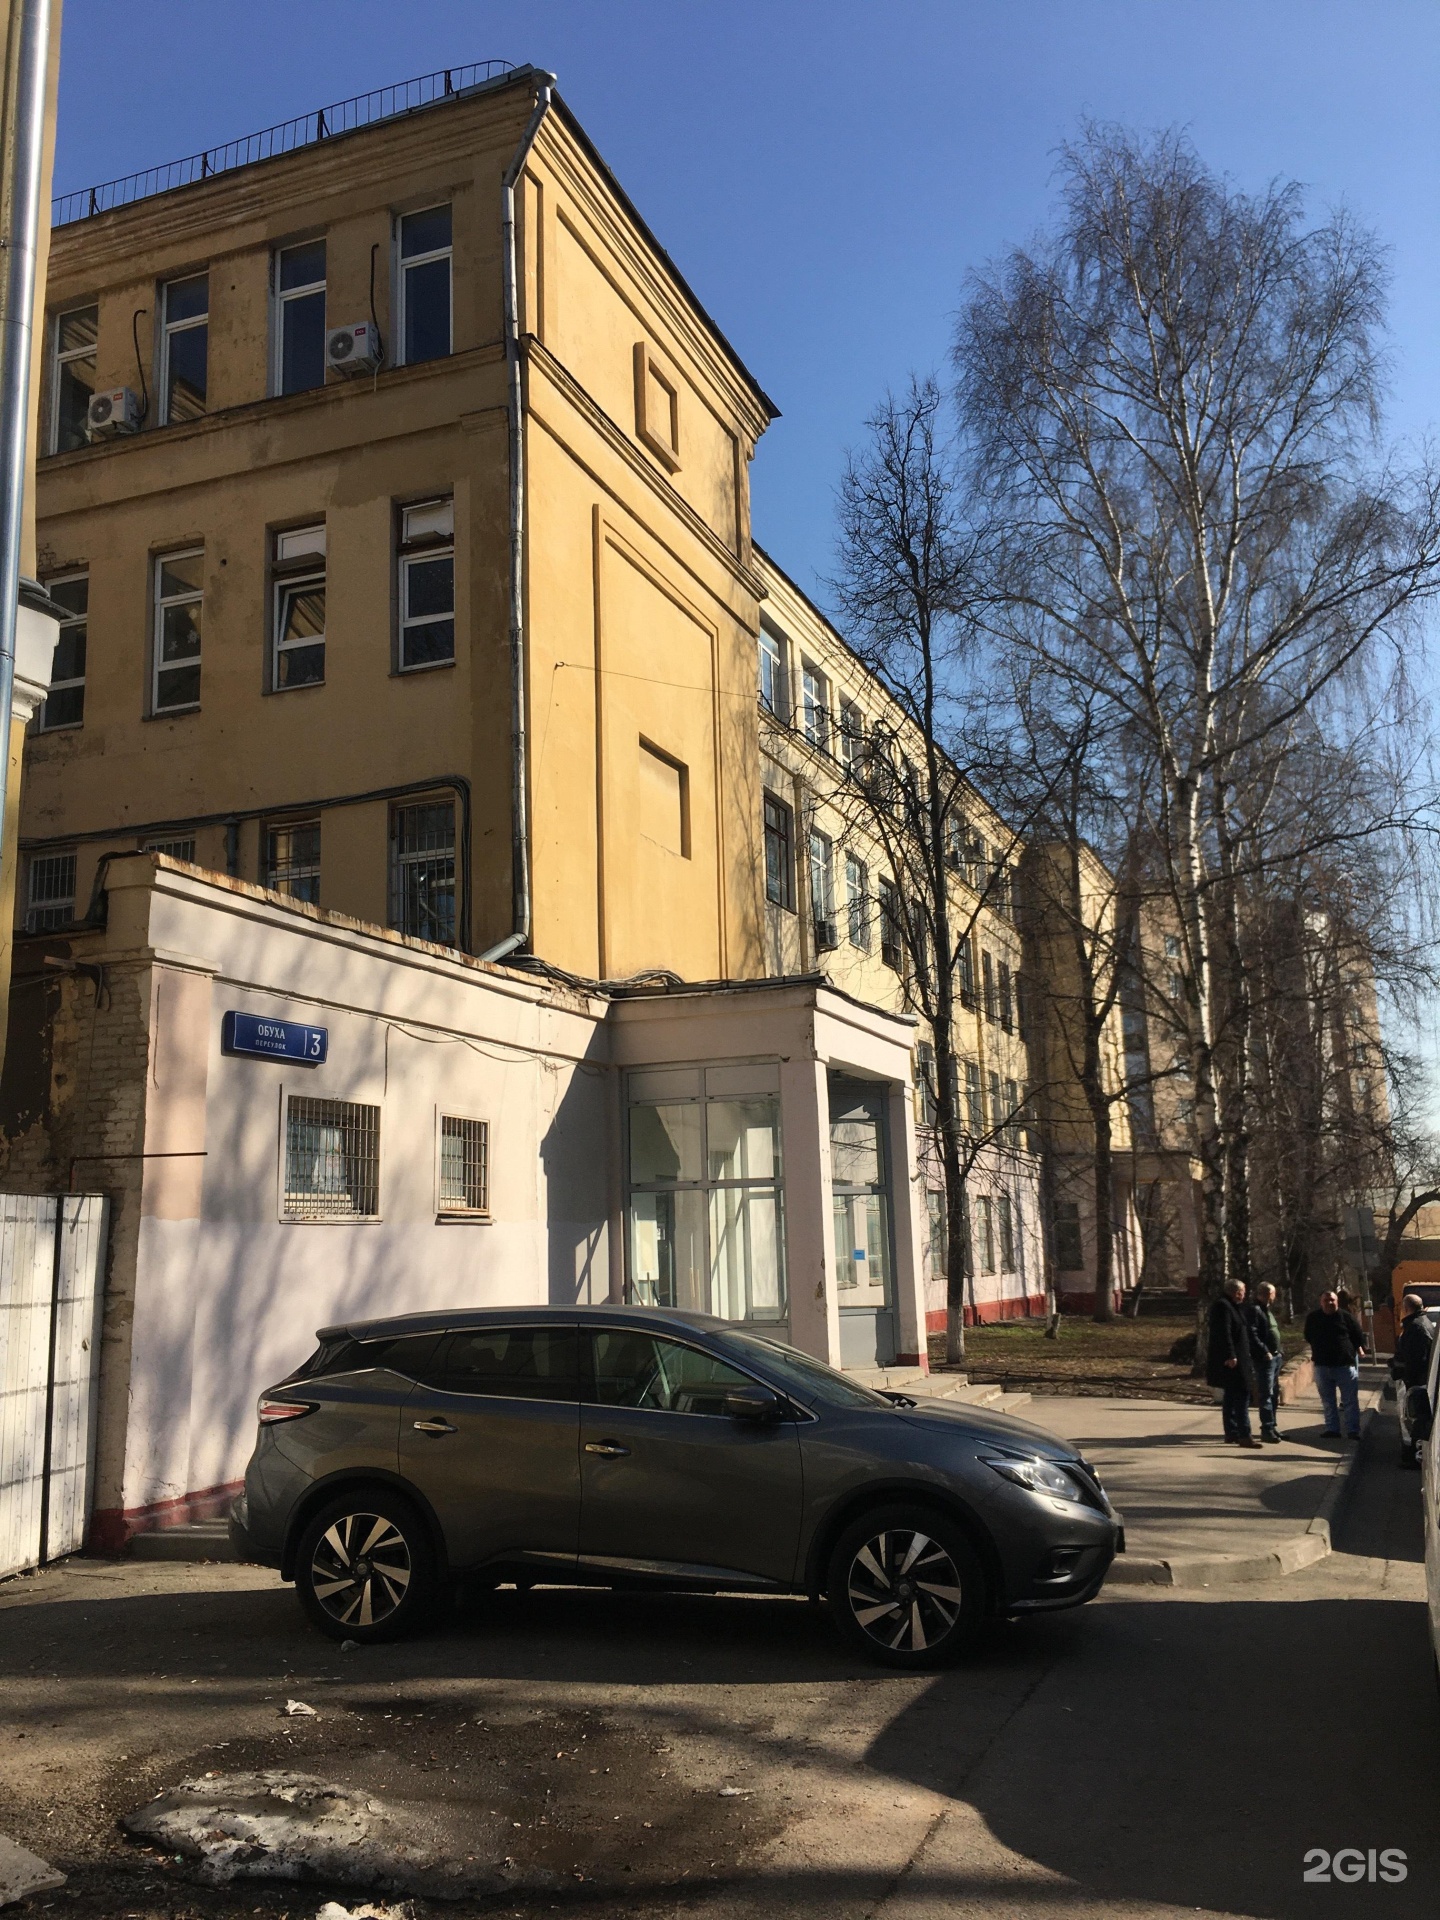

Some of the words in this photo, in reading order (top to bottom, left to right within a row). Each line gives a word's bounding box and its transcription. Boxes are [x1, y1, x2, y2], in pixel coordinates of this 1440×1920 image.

[258, 1024, 286, 1039] ОБУХА
[255, 1039, 287, 1050] ПЕРЕУЛОК
[311, 1033, 321, 1056] 3
